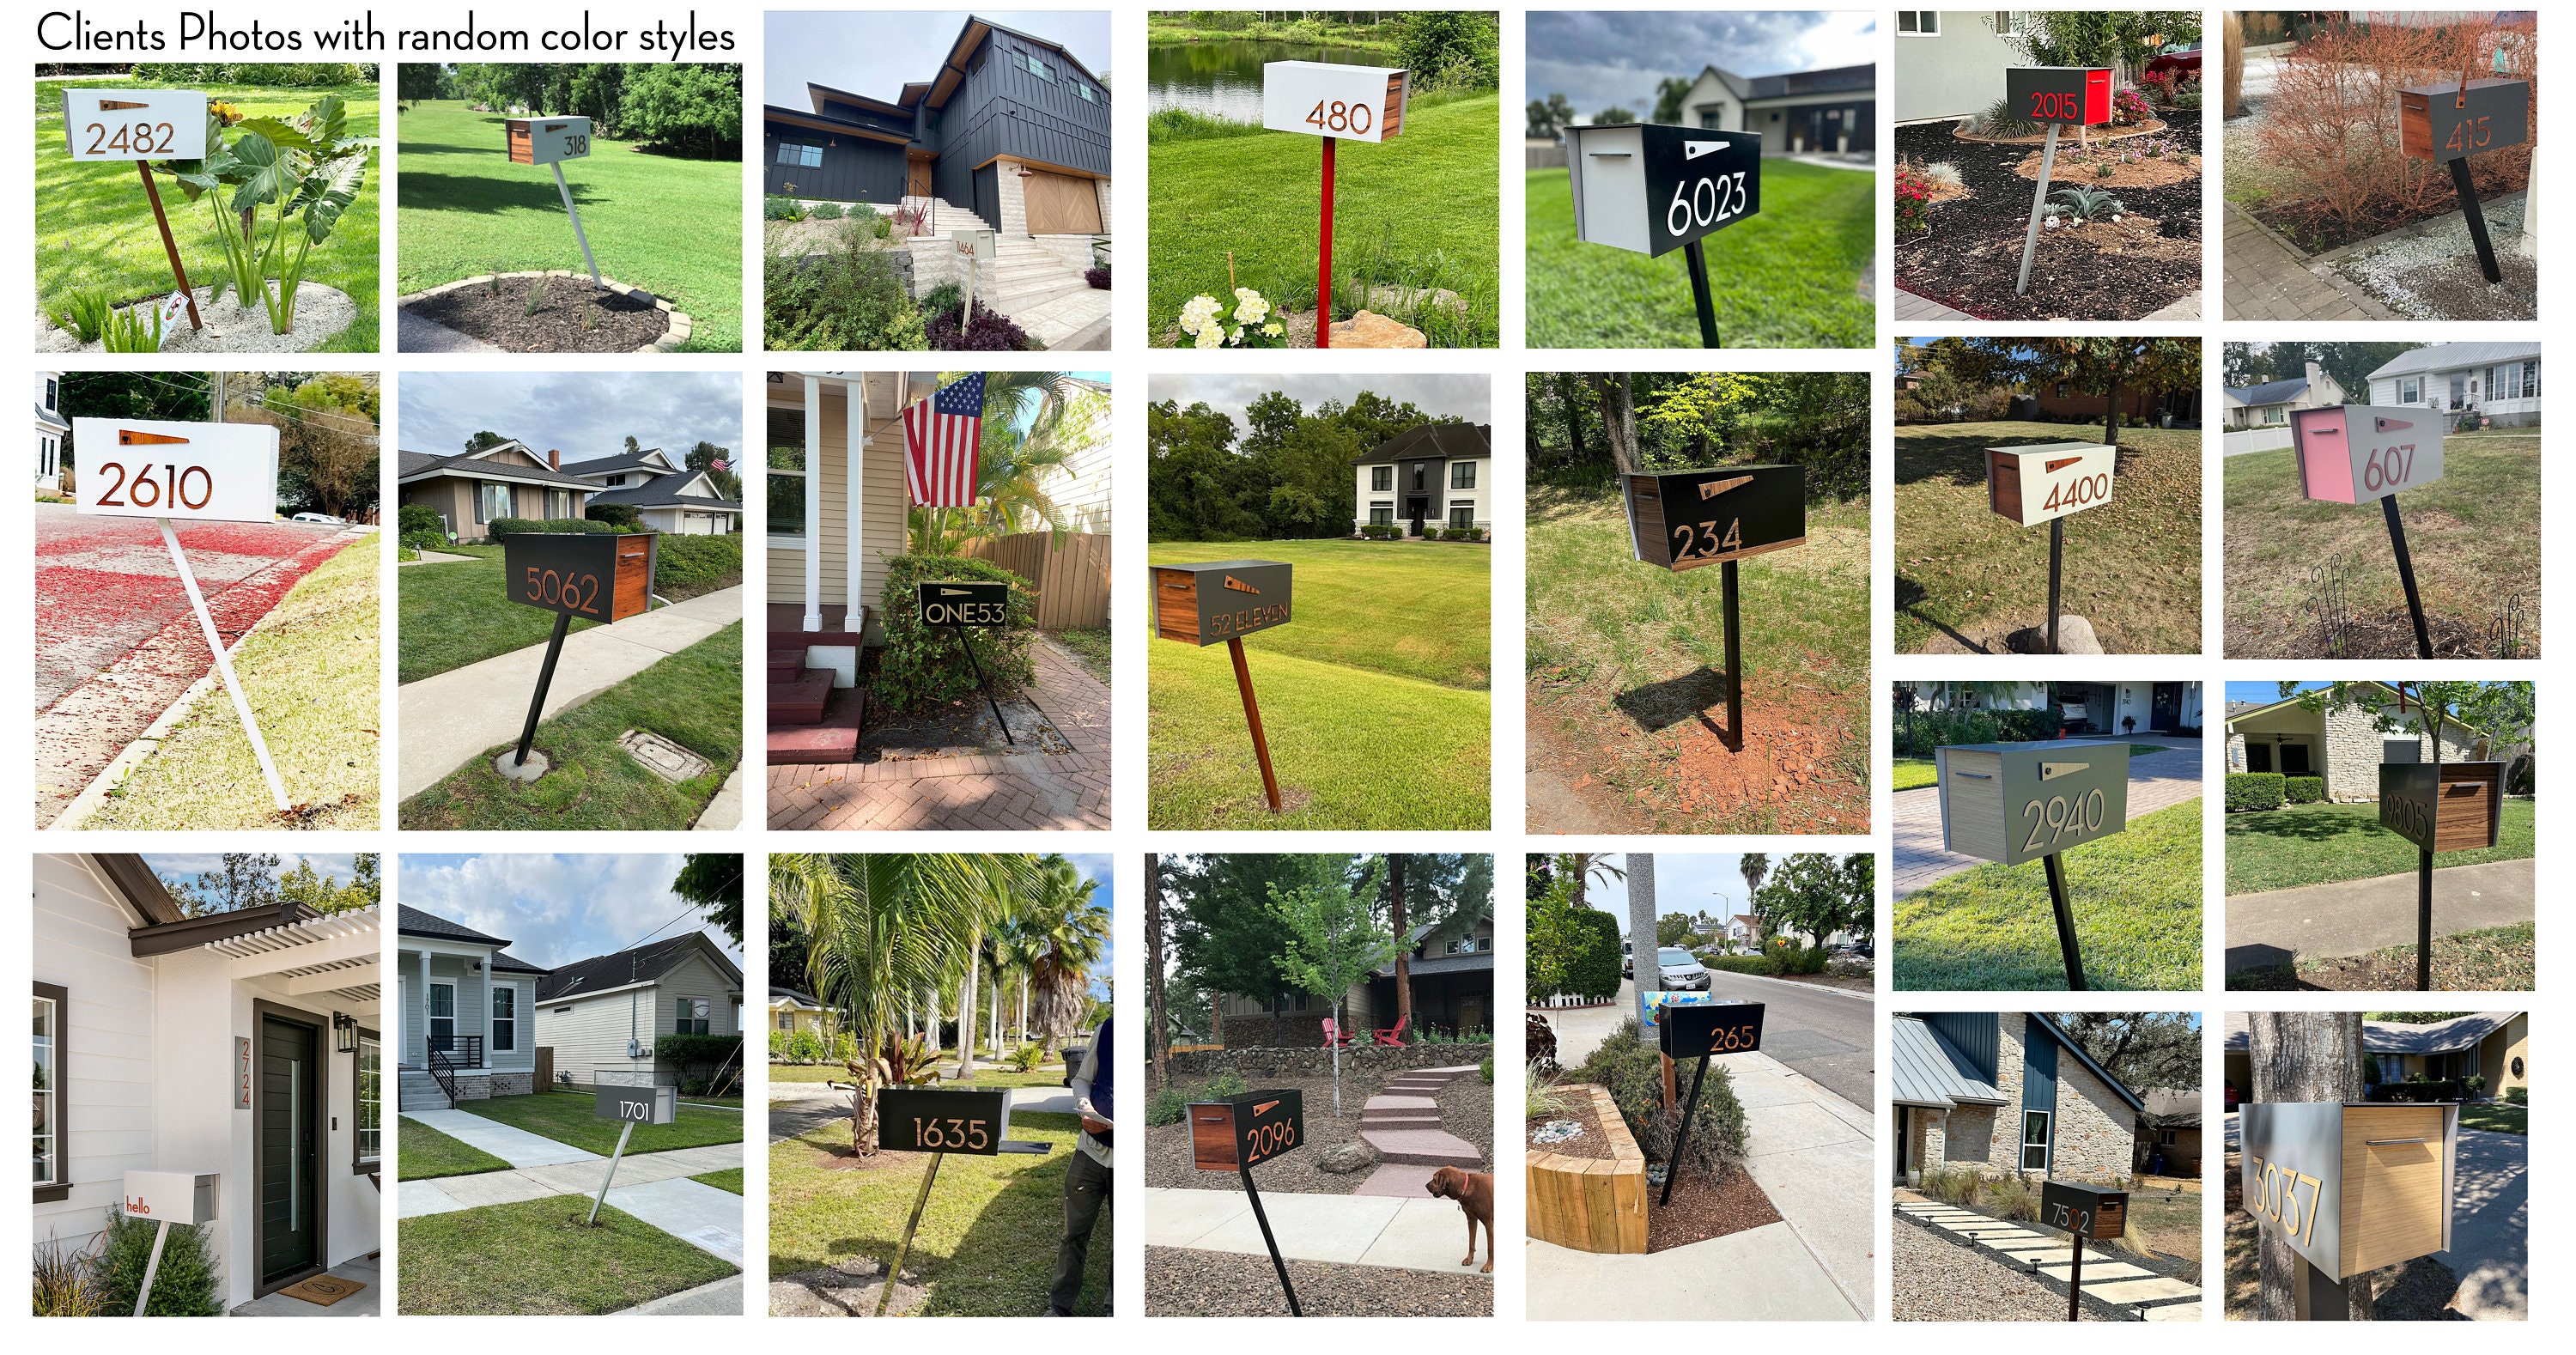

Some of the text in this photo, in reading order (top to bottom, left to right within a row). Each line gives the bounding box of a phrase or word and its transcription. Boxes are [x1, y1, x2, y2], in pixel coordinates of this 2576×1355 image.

[1305, 99, 1372, 134] 480
[2031, 92, 2078, 119] 2015
[85, 123, 174, 155] 2482
[564, 135, 586, 155] 318
[2445, 116, 2491, 152] 415
[1667, 172, 1747, 237] 6023
[956, 240, 975, 257] 11464
[2364, 444, 2417, 492] 607
[97, 463, 213, 510] 2610
[2043, 472, 2109, 513] 4400
[1674, 517, 1741, 562] 234
[526, 567, 600, 615] 5062
[926, 603, 1006, 625] ONE53
[1210, 603, 1290, 638] 52 ELEVEN
[2020, 788, 2105, 853] 2940
[2386, 793, 2427, 841] 9805
[1710, 1025, 1754, 1052] 265
[242, 1041, 251, 1106] 2724
[619, 1101, 651, 1121] 1701
[914, 1117, 989, 1150] 1635
[1247, 1118, 1296, 1164] 2096
[125, 1195, 150, 1216] hello
[2052, 1202, 2090, 1235] 7502
[2251, 1156, 2322, 1248] 3037
